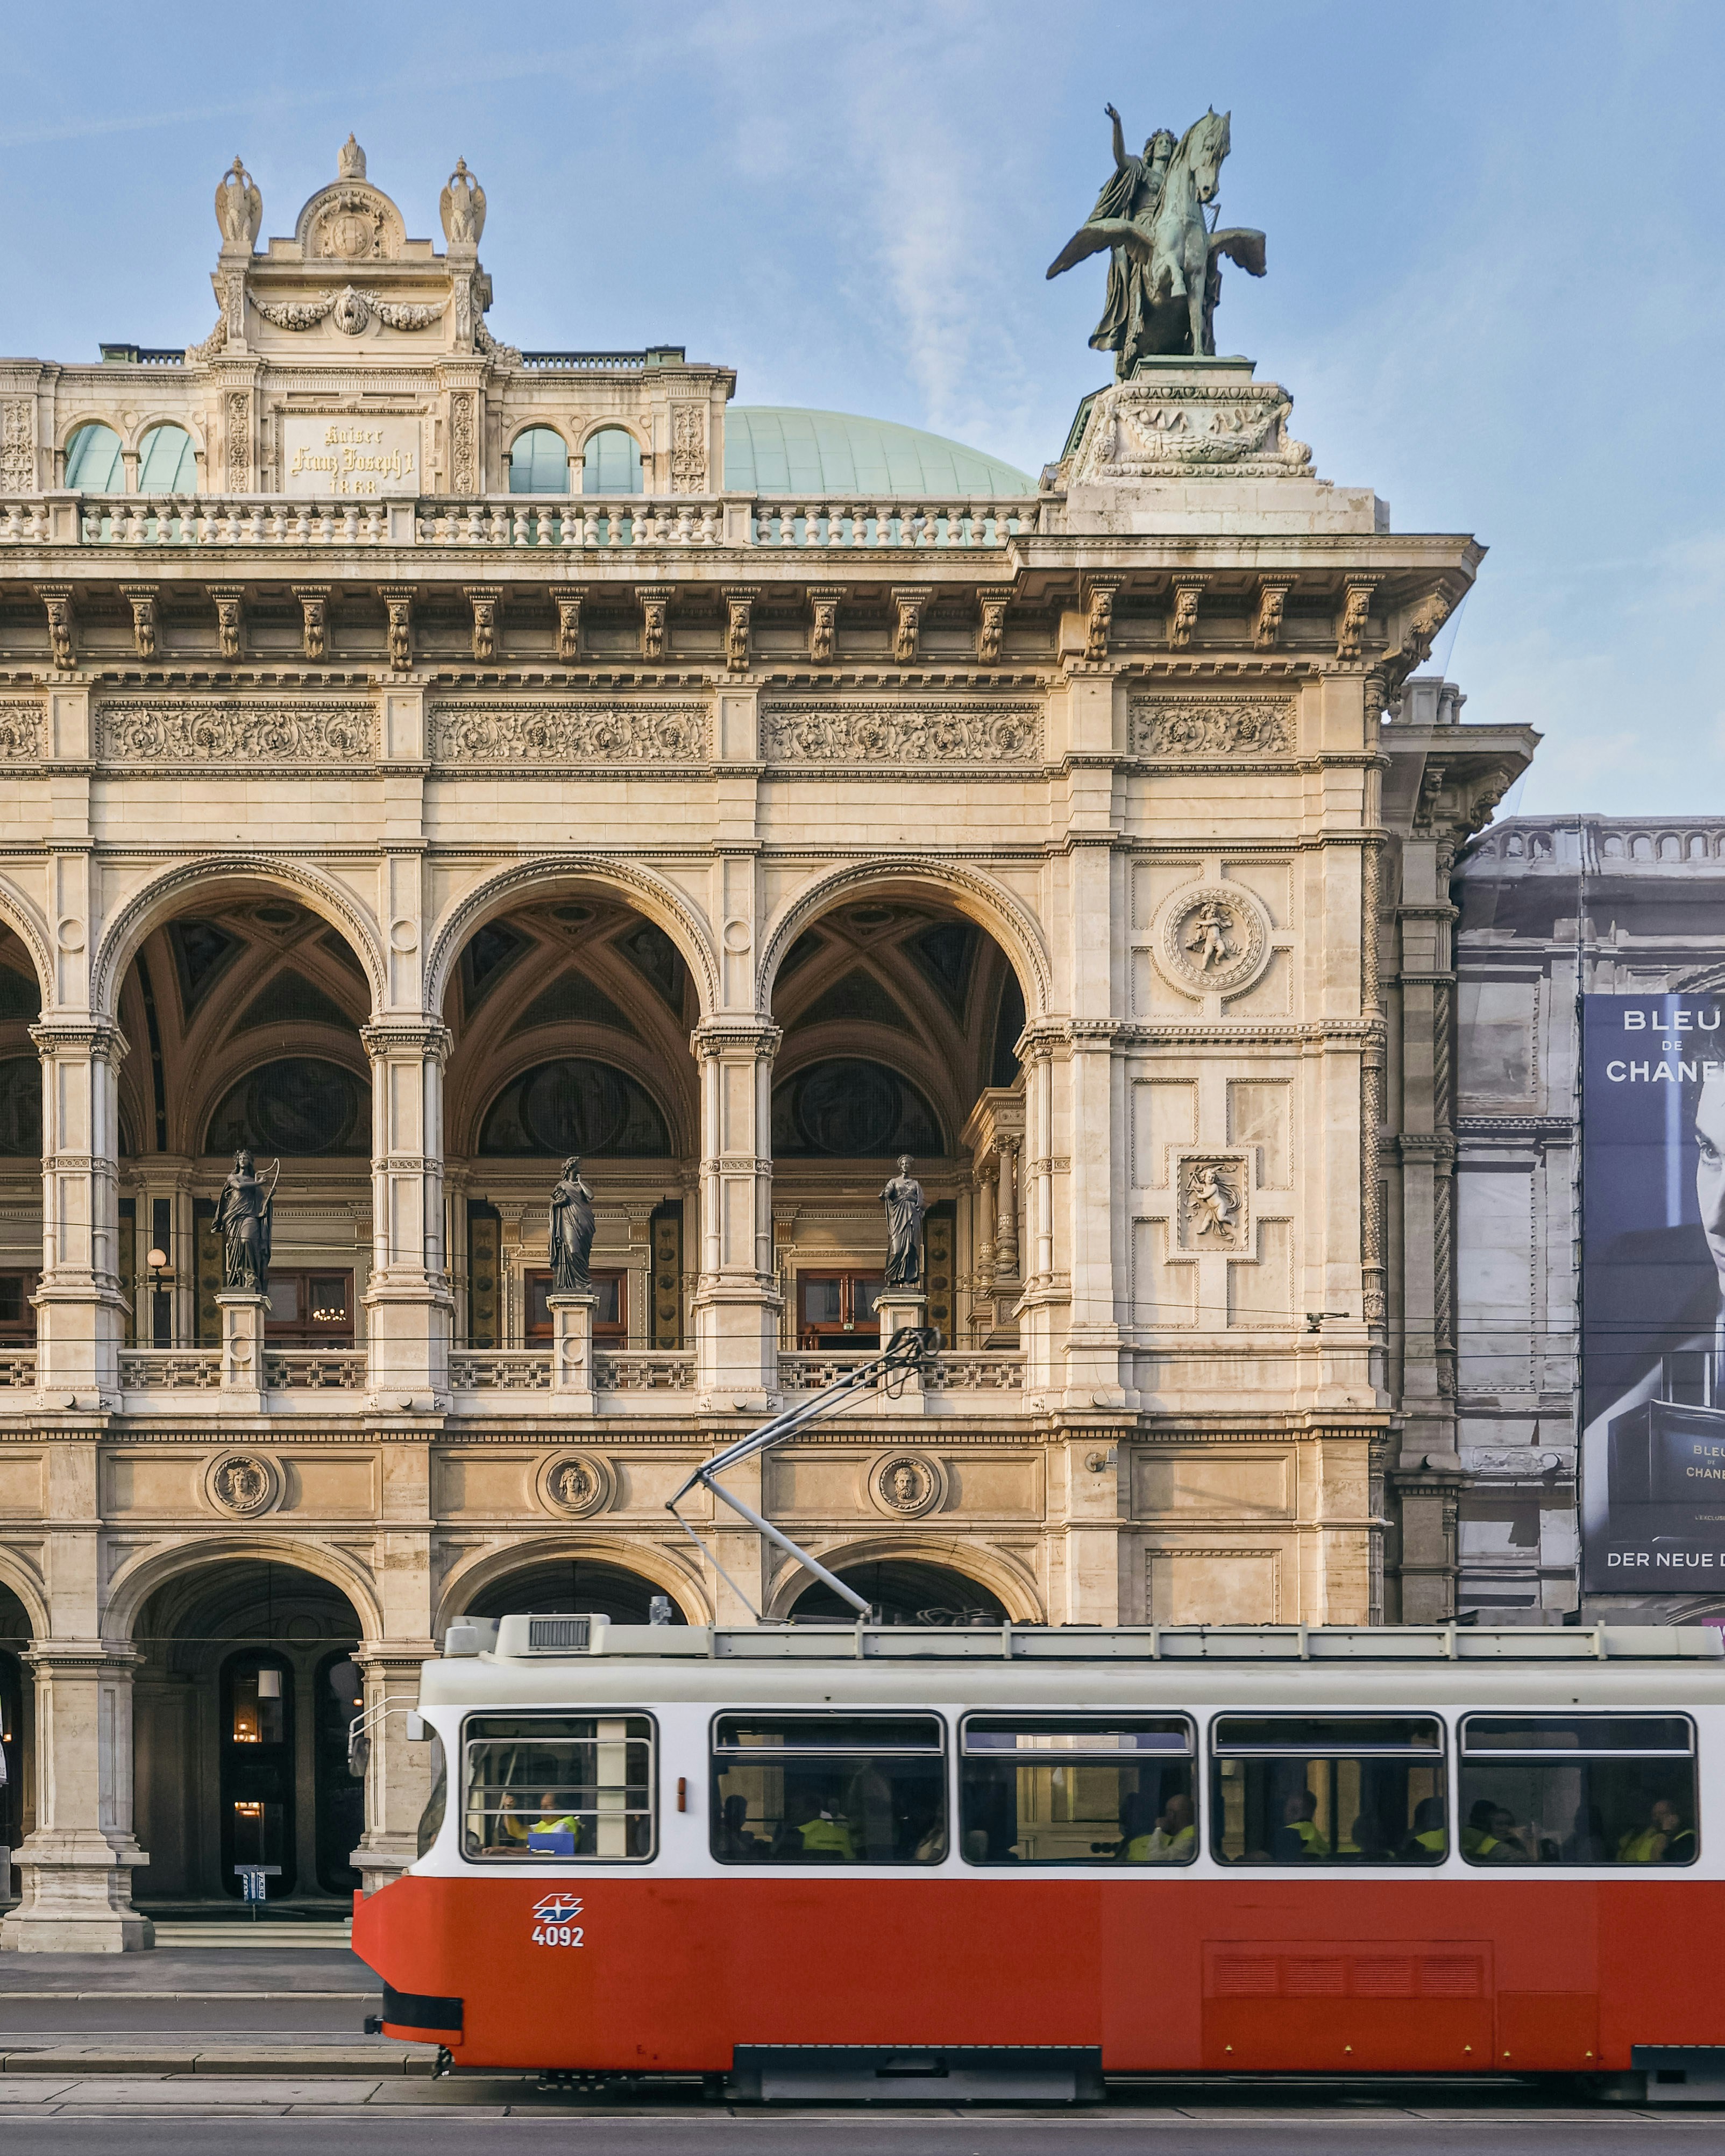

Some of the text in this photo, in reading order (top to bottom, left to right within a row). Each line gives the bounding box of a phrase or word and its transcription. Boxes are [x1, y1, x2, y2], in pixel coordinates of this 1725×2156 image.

[325, 426, 383, 445] Kaiser
[290, 446, 338, 478] Franz
[342, 446, 401, 479] Joseph
[330, 480, 376, 494] 1868
[1624, 1011, 1721, 1030] BLEU
[1662, 1041, 1683, 1050] DE
[1606, 1061, 1725, 1082] CHANE
[1608, 1553, 1649, 1567] DER
[1657, 1553, 1713, 1567] NEUE
[531, 1926, 584, 1946] 4092
